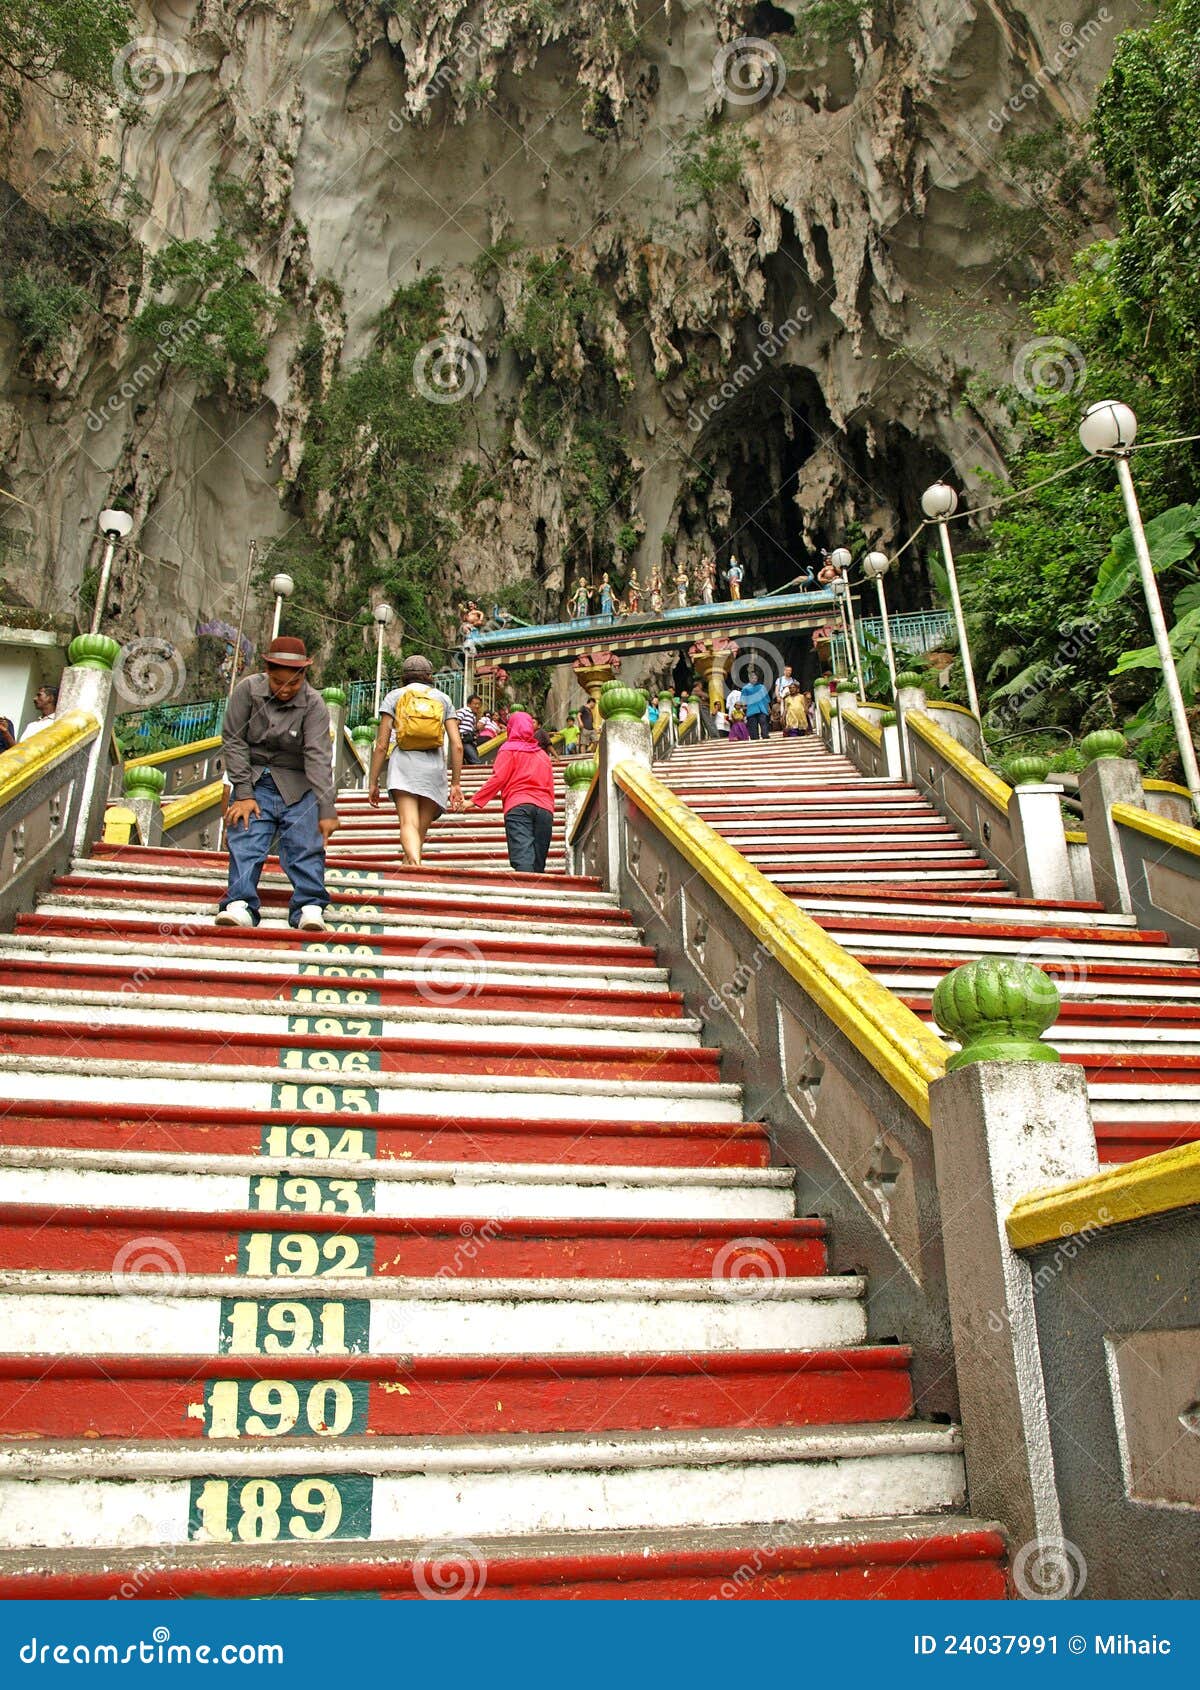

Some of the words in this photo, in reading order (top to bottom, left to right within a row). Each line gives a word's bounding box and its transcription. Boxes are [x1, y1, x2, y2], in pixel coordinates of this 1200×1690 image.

[284, 1050, 371, 1071] 196
[278, 1085, 372, 1113] 195
[266, 1126, 371, 1159] 194
[255, 1176, 364, 1217] 193
[246, 1232, 367, 1277] 192
[228, 1302, 349, 1354] 191
[208, 1379, 353, 1438] 190
[194, 1478, 342, 1542] 189
